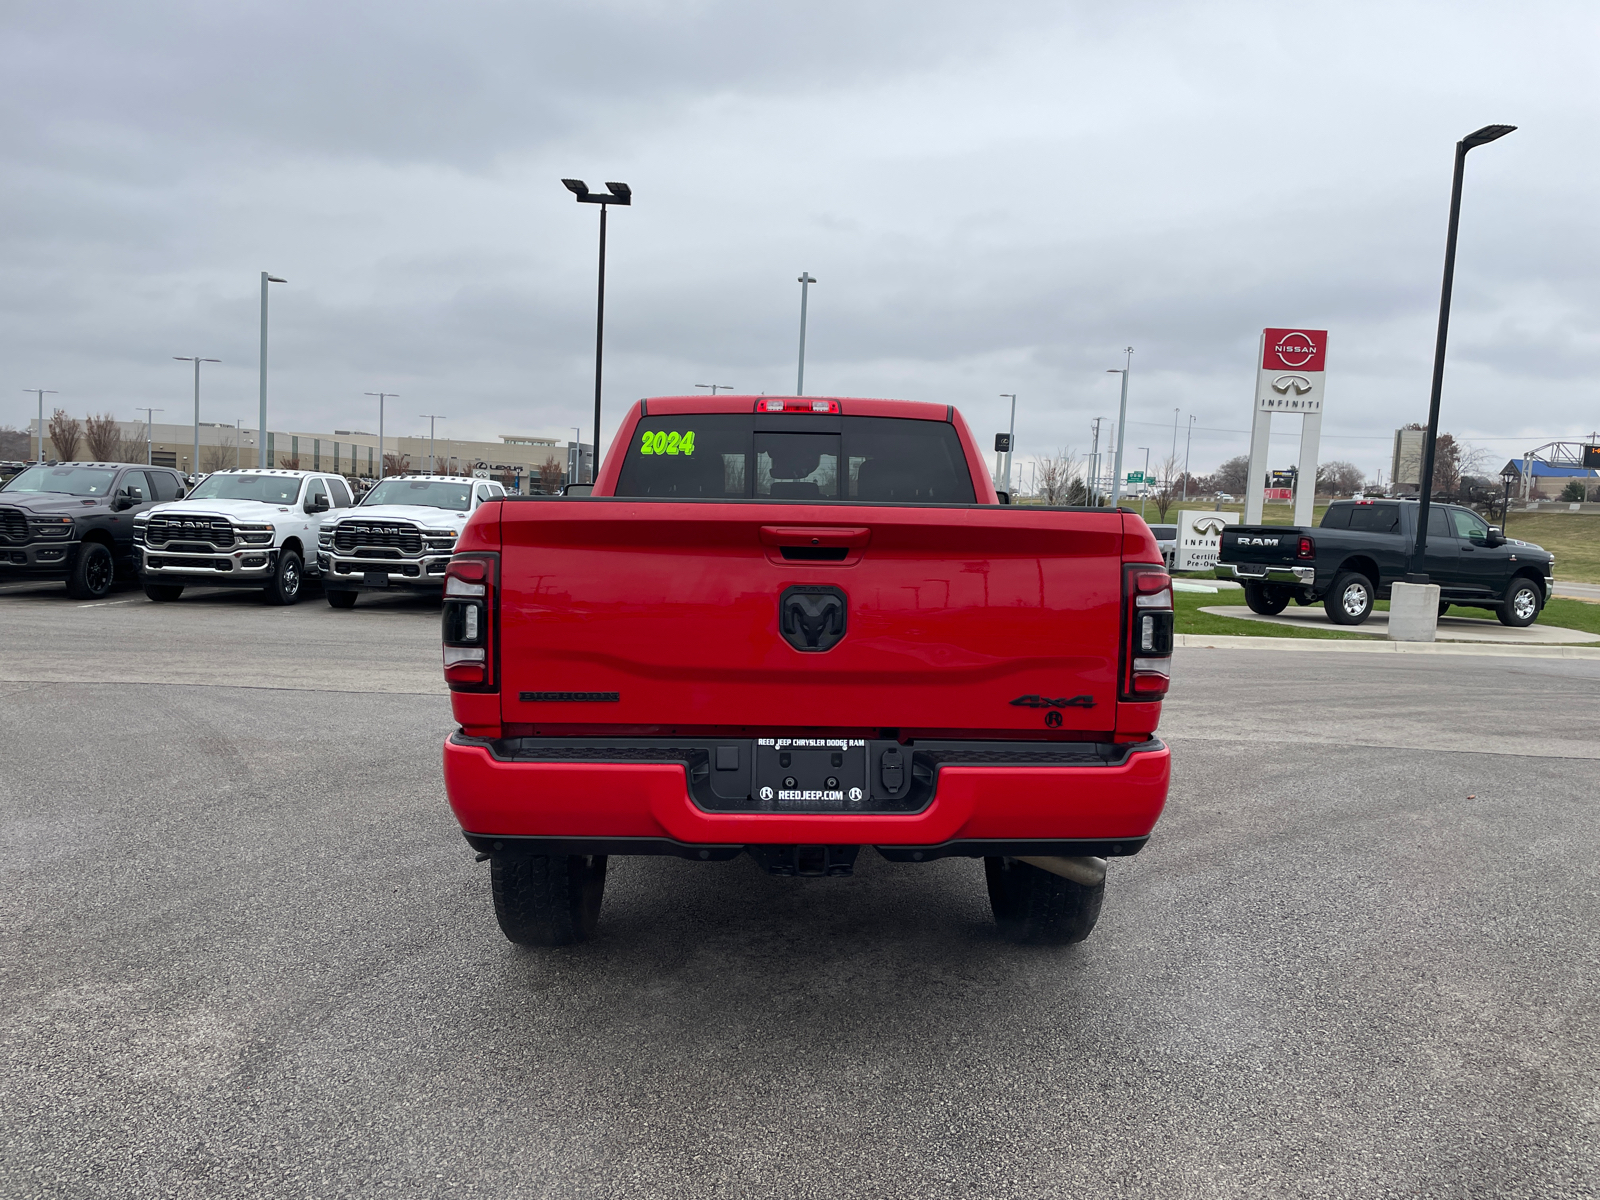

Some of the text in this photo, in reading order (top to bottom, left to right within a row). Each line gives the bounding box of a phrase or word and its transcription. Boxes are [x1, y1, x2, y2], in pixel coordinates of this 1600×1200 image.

[1275, 345, 1316, 353] NISSAN
[1262, 399, 1319, 408] INFINITI
[640, 431, 695, 455] 2024
[357, 526, 398, 534] RAM
[1185, 539, 1216, 547] INFIN
[1238, 537, 1278, 546] RAM
[758, 738, 774, 746] REED
[776, 739, 791, 747] JEEP
[827, 739, 848, 747] DODGE
[778, 790, 843, 800] REEDJEEP.COM
